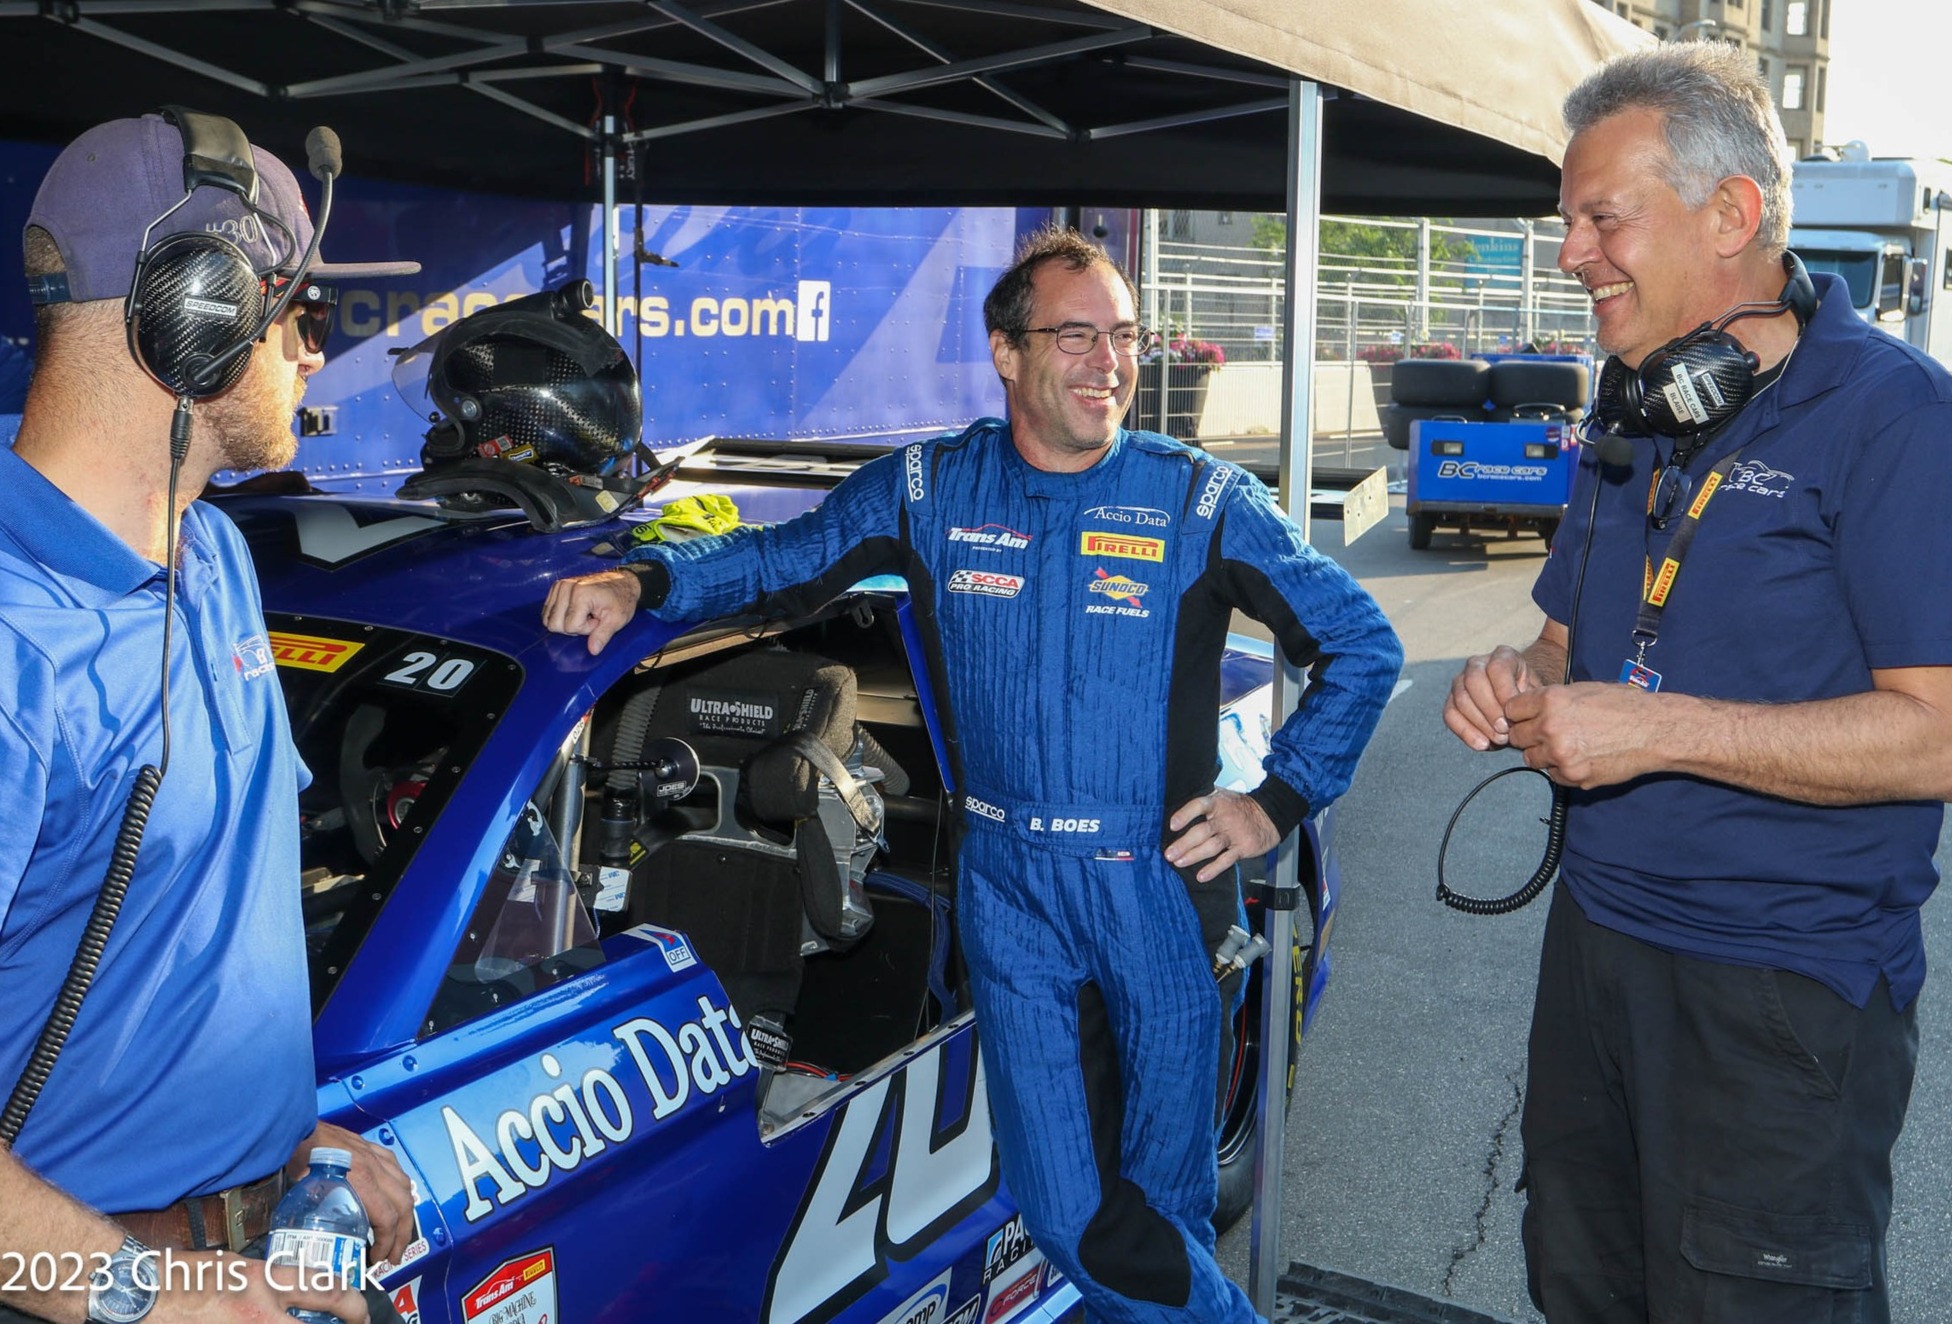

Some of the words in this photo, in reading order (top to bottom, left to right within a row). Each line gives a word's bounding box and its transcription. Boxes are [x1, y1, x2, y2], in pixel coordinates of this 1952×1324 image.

[185, 299, 236, 316] SPEEDCOM
[1702, 372, 1724, 405] SPEEDCOM
[1669, 391, 1685, 415] BLAISE
[1681, 384, 1692, 404] RACE
[1689, 403, 1702, 419] CARS
[905, 444, 925, 502] sparco
[1438, 461, 1479, 479] BC
[1474, 465, 1510, 475] race
[1510, 466, 1548, 477] cars
[1738, 470, 1769, 486] BC
[1196, 465, 1234, 520] sparco
[1691, 475, 1718, 515] PIRELLI
[1747, 483, 1787, 499] cars
[1093, 507, 1132, 523] Accio
[1134, 512, 1168, 527] Data
[947, 527, 998, 544] Trans
[994, 532, 1029, 549] Am
[1087, 535, 1159, 557] PIRELLI
[949, 583, 972, 591] PRO
[972, 584, 1016, 596] RACING
[970, 573, 1019, 589] SCCA
[1091, 580, 1148, 595] SUNOCO
[1651, 561, 1676, 603] PIRELLI
[1085, 605, 1116, 615] RACE
[1115, 607, 1150, 618] FUELS
[384, 651, 474, 690] 20
[699, 714, 721, 722] RACE
[725, 716, 765, 727] PRODUCTS
[965, 795, 1006, 824] sparco
[1030, 817, 1045, 832] B.
[1050, 818, 1101, 833] BOES
[668, 947, 687, 962] OFF
[441, 1053, 634, 1223] Accio
[403, 1242, 428, 1262] SERIES
[982, 1240, 1034, 1285] RACI
[475, 1289, 499, 1310] Trans
[498, 1280, 514, 1297] Am
